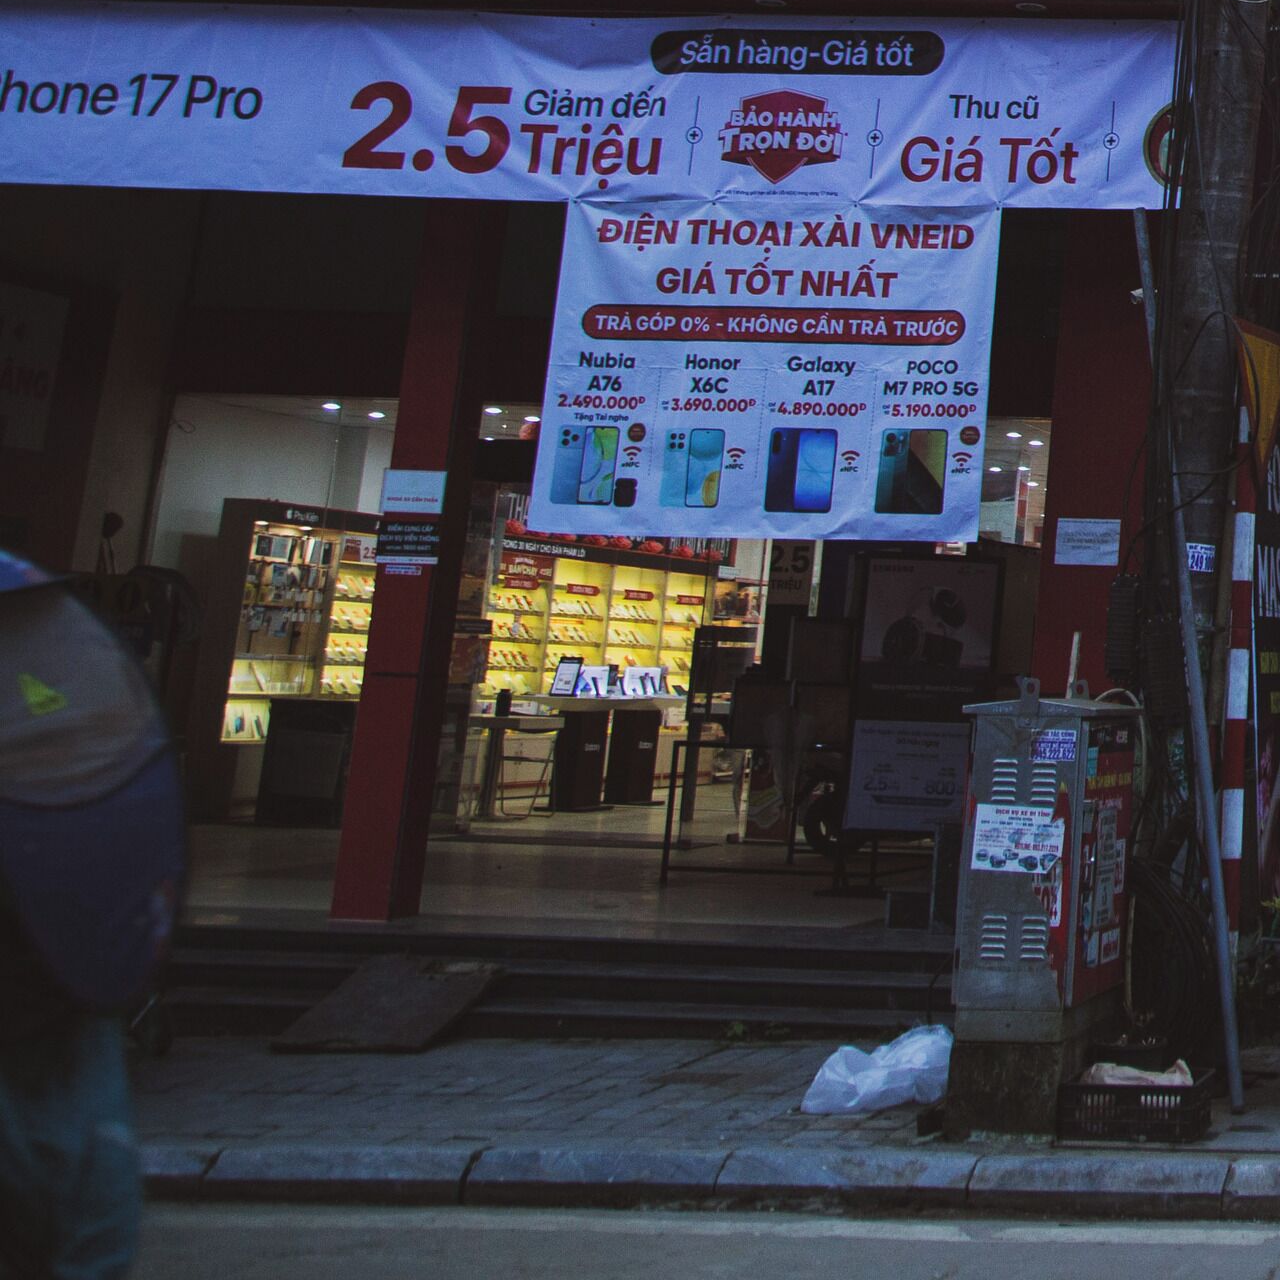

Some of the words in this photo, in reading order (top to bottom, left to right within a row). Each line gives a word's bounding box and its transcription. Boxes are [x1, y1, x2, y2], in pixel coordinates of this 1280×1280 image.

[680, 32, 733, 66] Sẵn
[875, 34, 915, 67] tốt
[0, 69, 119, 117] hone
[128, 73, 180, 118] 17
[184, 74, 264, 120] Pro
[524, 87, 602, 119] Giảm
[612, 85, 666, 120] đến
[949, 93, 1001, 119] Thu
[1004, 94, 1040, 121] cũ
[342, 81, 512, 174] 2.5
[731, 104, 774, 129] BẢO
[778, 101, 840, 129] HÀNH
[719, 126, 794, 156] TRỌN
[520, 123, 662, 190] Triệu
[900, 133, 987, 185] Giá
[1000, 127, 1080, 185] Tốt
[597, 212, 684, 252] ĐIỆN
[687, 219, 793, 254] THOẠI
[800, 214, 862, 249] XÀI
[870, 222, 975, 251] VNEID
[656, 261, 715, 295] GIÁ
[725, 255, 796, 296] TỐT
[800, 258, 899, 299] NHẤT
[636, 312, 676, 332] GÓP
[681, 316, 711, 333] 0%
[727, 313, 799, 334] KHÔNG
[893, 316, 959, 337] TRƯỚC
[579, 351, 636, 371] Nubia
[685, 353, 742, 372] Honor
[786, 355, 857, 377] Galaxy
[905, 358, 959, 376] POCO
[588, 375, 622, 393] A76
[690, 376, 730, 395] X6C
[803, 379, 835, 397] A17
[911, 381, 948, 397] PRO
[952, 381, 979, 398] 5G
